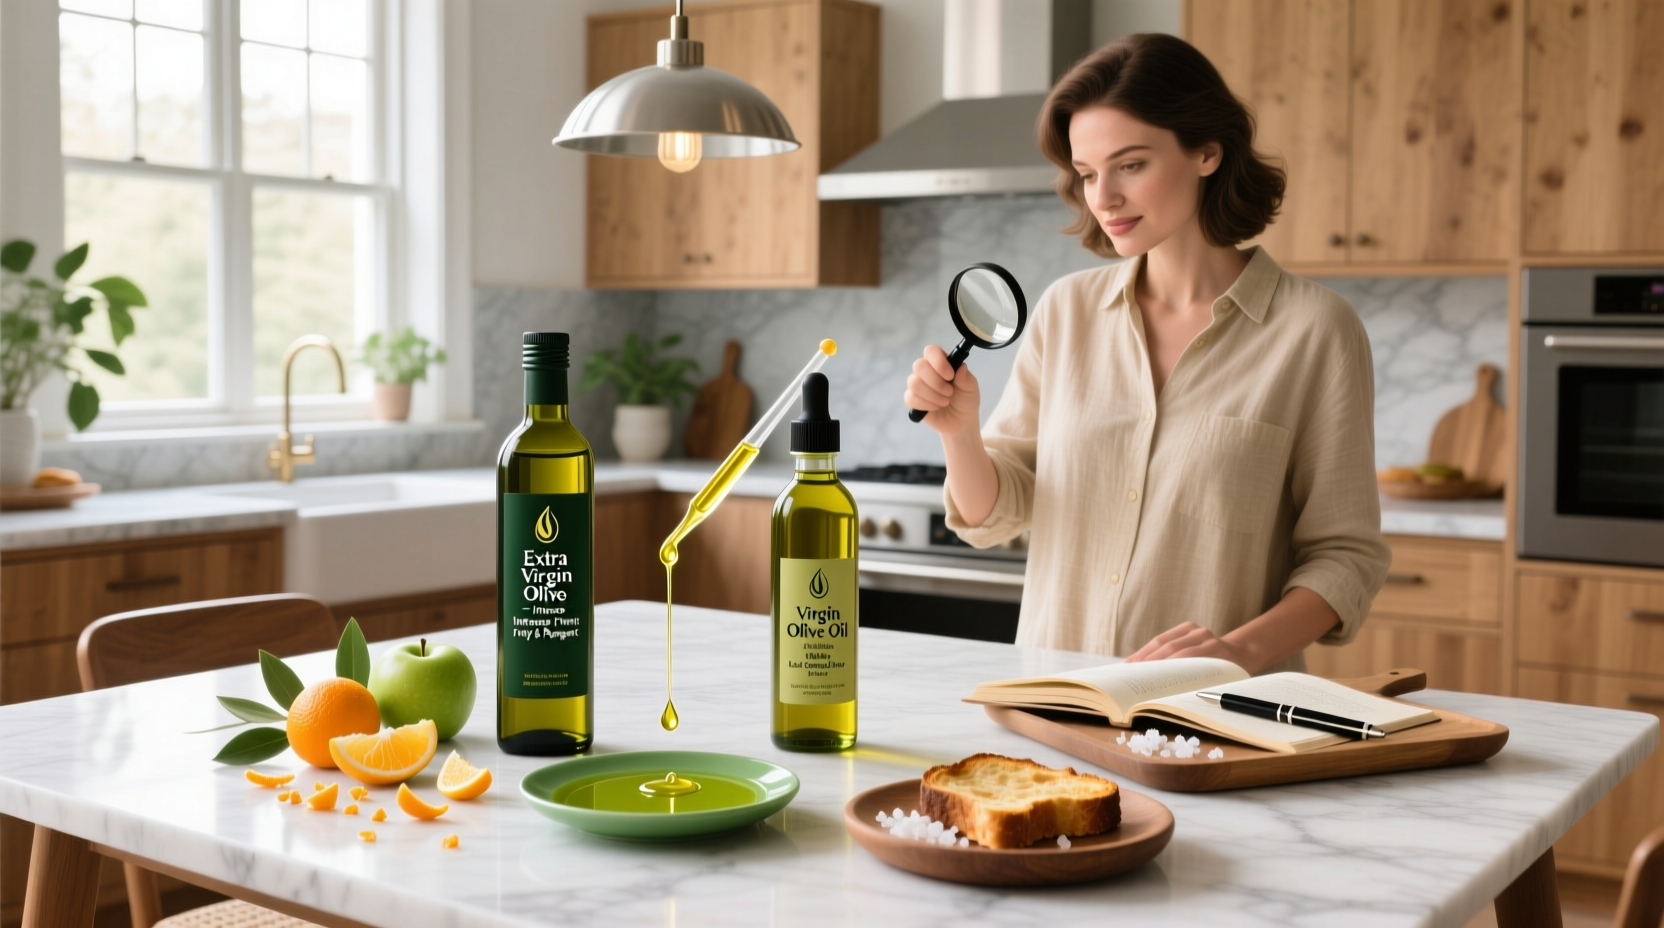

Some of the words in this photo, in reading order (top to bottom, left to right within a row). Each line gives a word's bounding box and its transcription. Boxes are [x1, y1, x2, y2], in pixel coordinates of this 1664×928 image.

[523, 549, 568, 567] Extra
[521, 567, 573, 588] Virgin
[523, 585, 567, 602] Olive
[796, 605, 840, 625] Virgin
[787, 622, 825, 639] Olive
[828, 622, 848, 639] Oil
